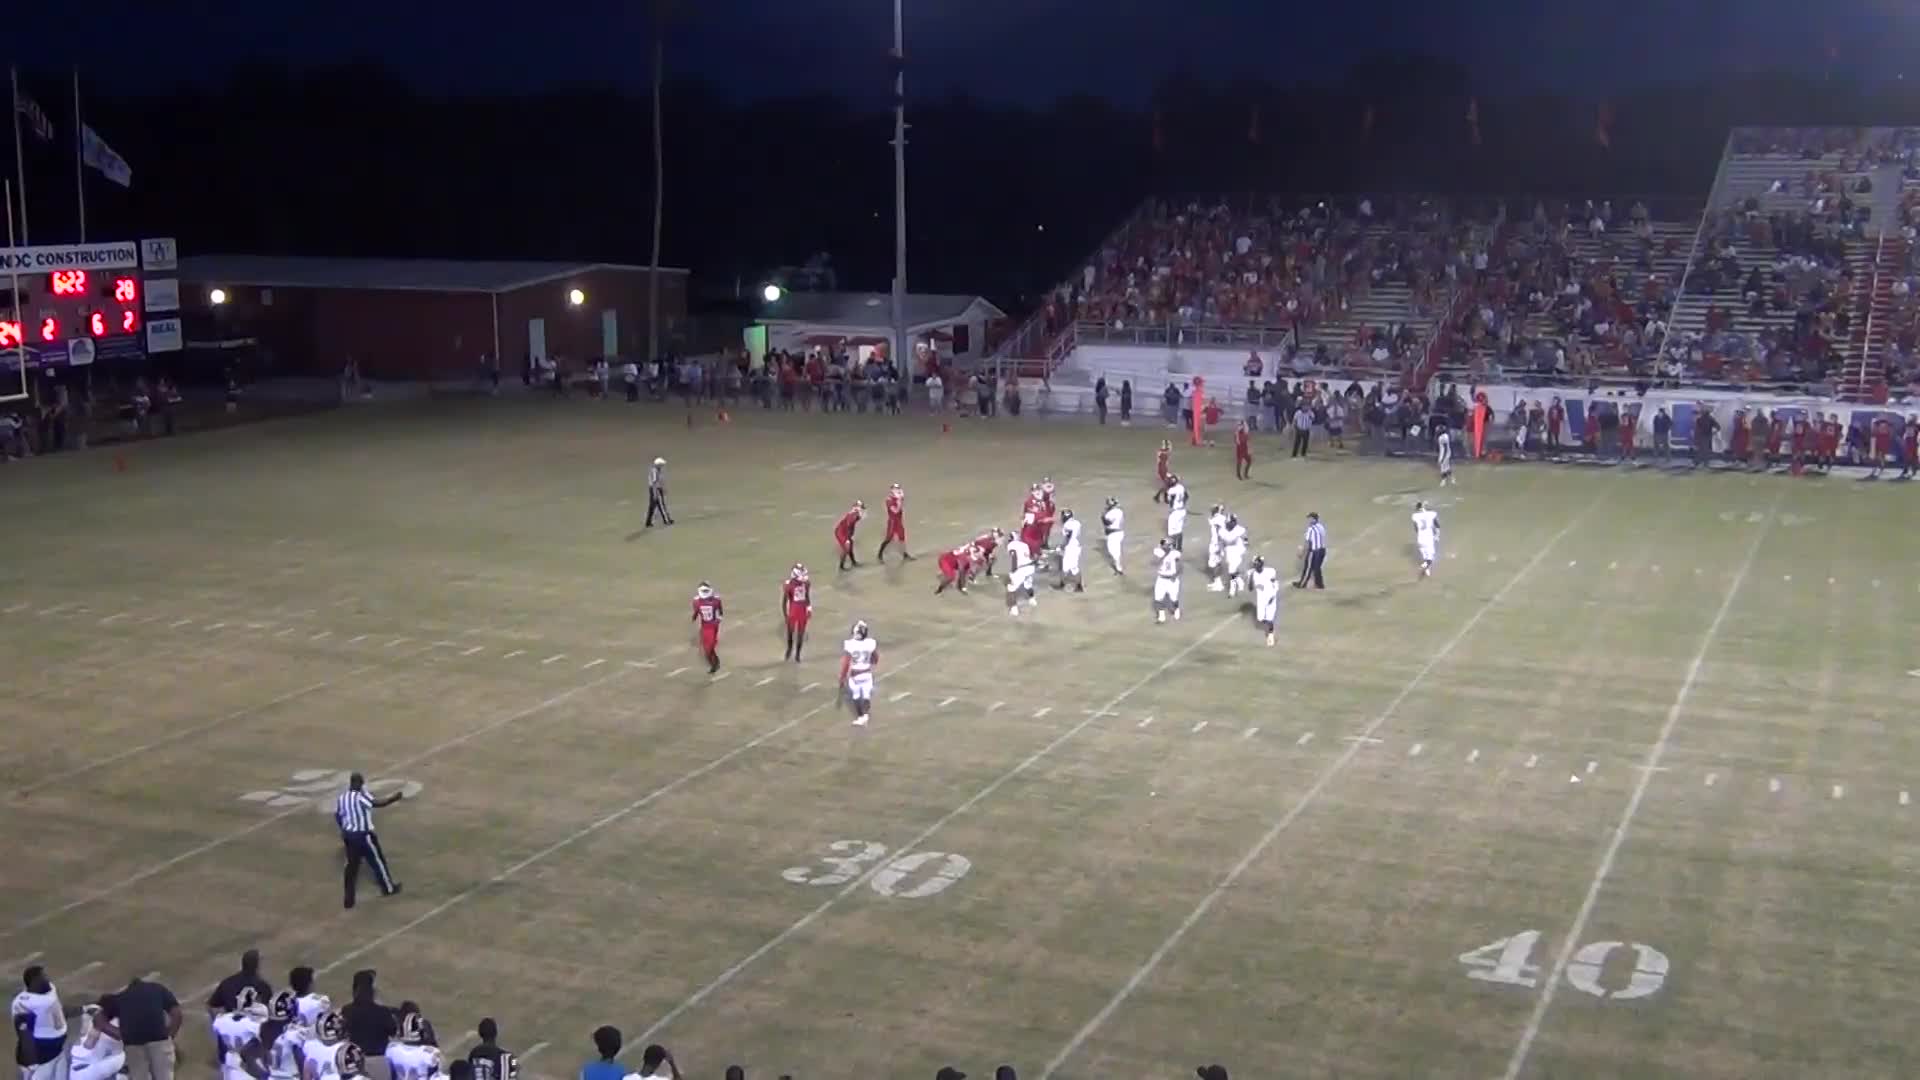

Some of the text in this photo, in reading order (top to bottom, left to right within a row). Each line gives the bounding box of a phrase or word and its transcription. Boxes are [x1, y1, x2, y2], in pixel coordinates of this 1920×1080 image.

[36, 247, 135, 266] CONSTRUCTION
[91, 312, 105, 336] 6
[780, 838, 973, 899] 30
[1457, 928, 1670, 1000] 40
